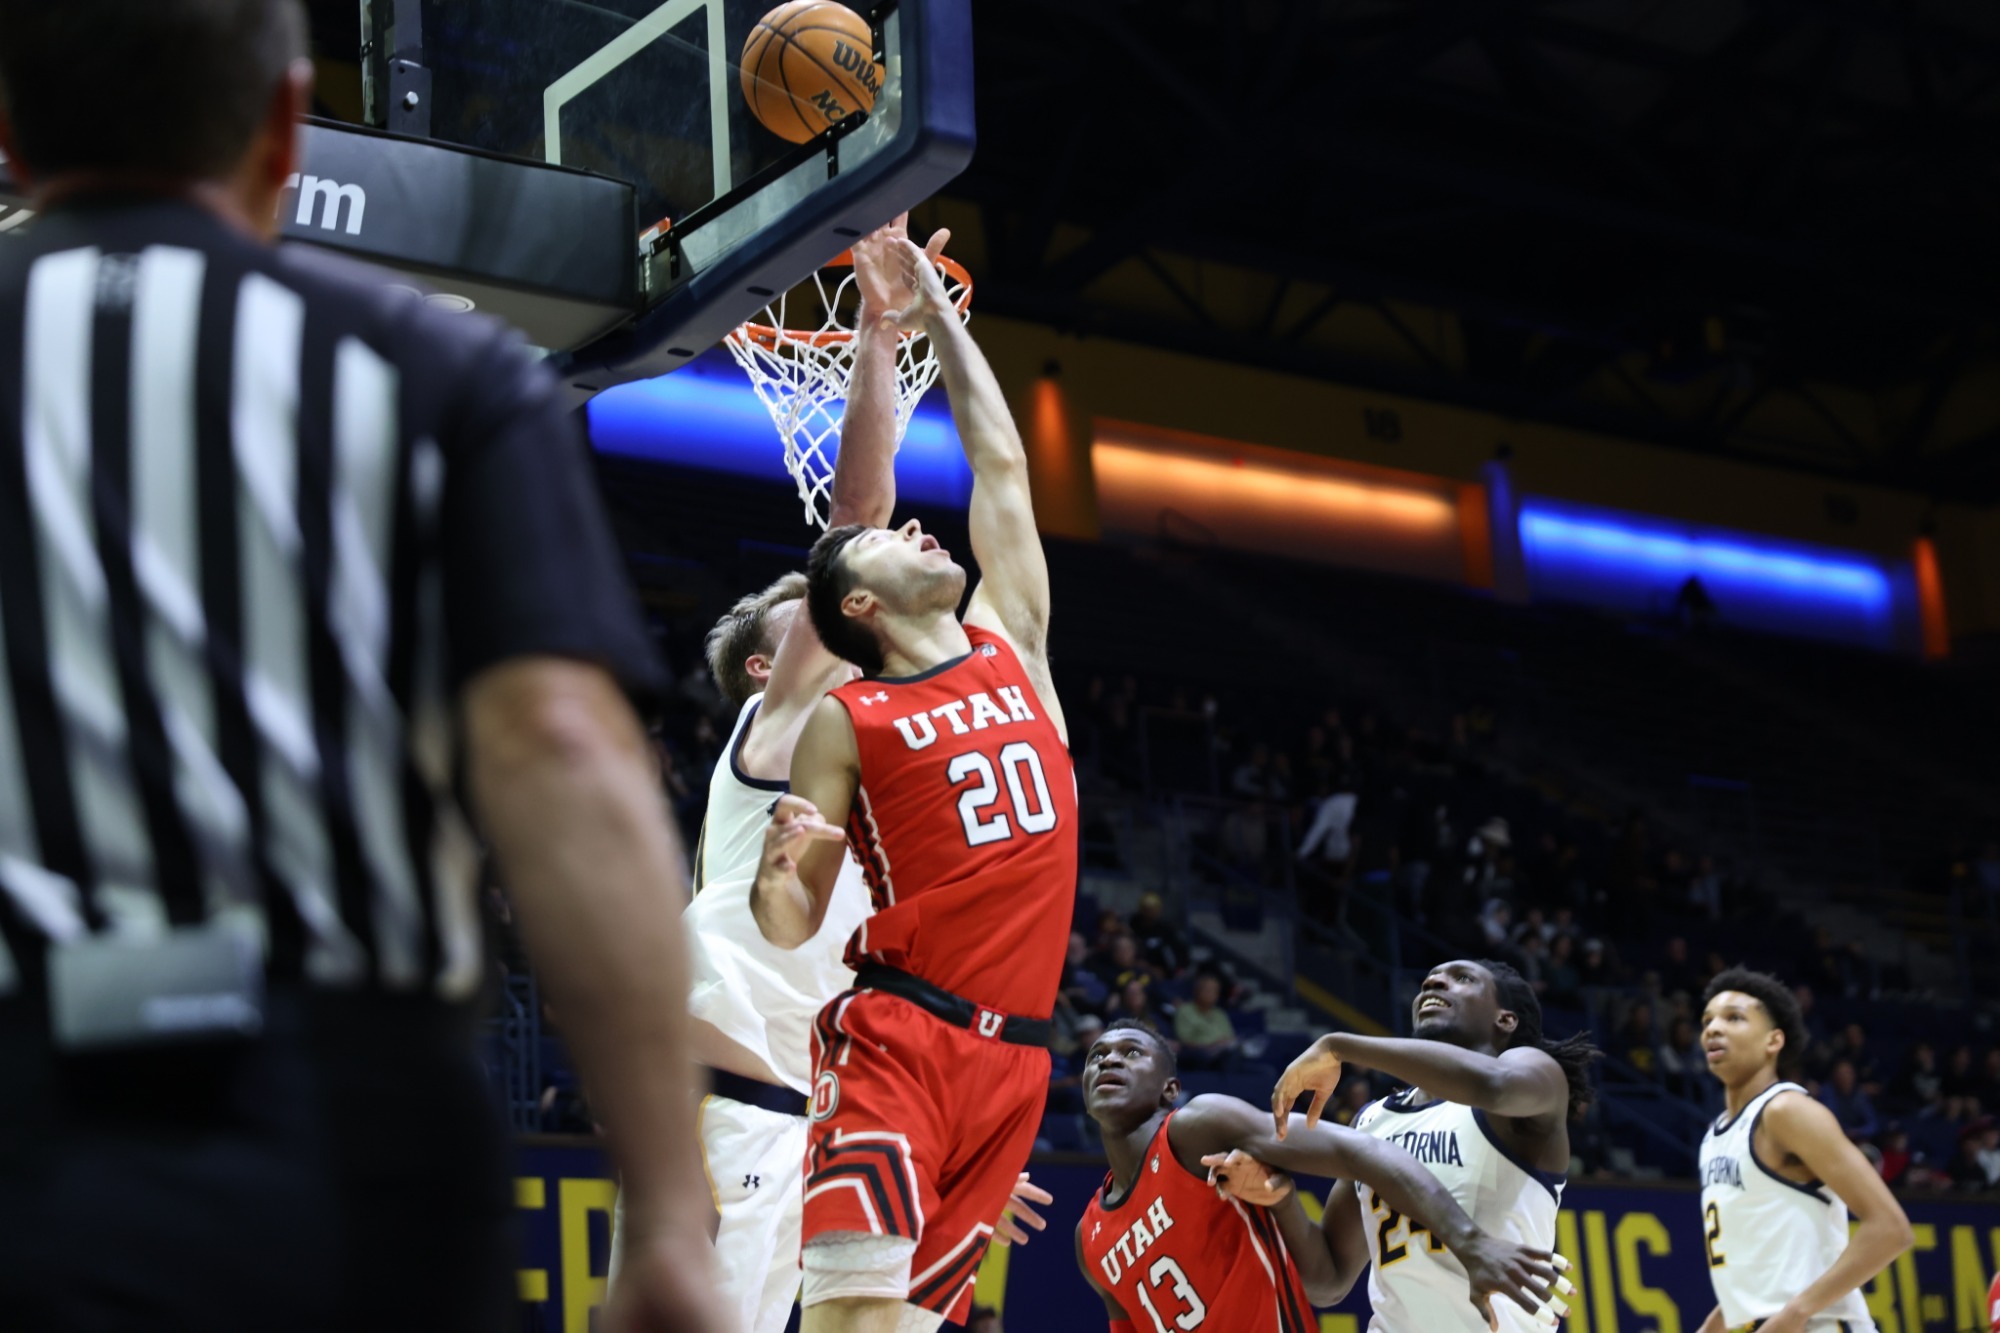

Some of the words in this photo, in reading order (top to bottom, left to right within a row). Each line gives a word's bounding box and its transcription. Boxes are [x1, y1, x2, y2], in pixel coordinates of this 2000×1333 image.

[833, 40, 880, 101] Wilso
[811, 89, 846, 123] NC
[893, 685, 1036, 751] UTAH
[946, 741, 1058, 848] 20
[977, 1009, 1003, 1038] U
[1101, 1195, 1174, 1286] UTAH
[1136, 1253, 1207, 1333] 13
